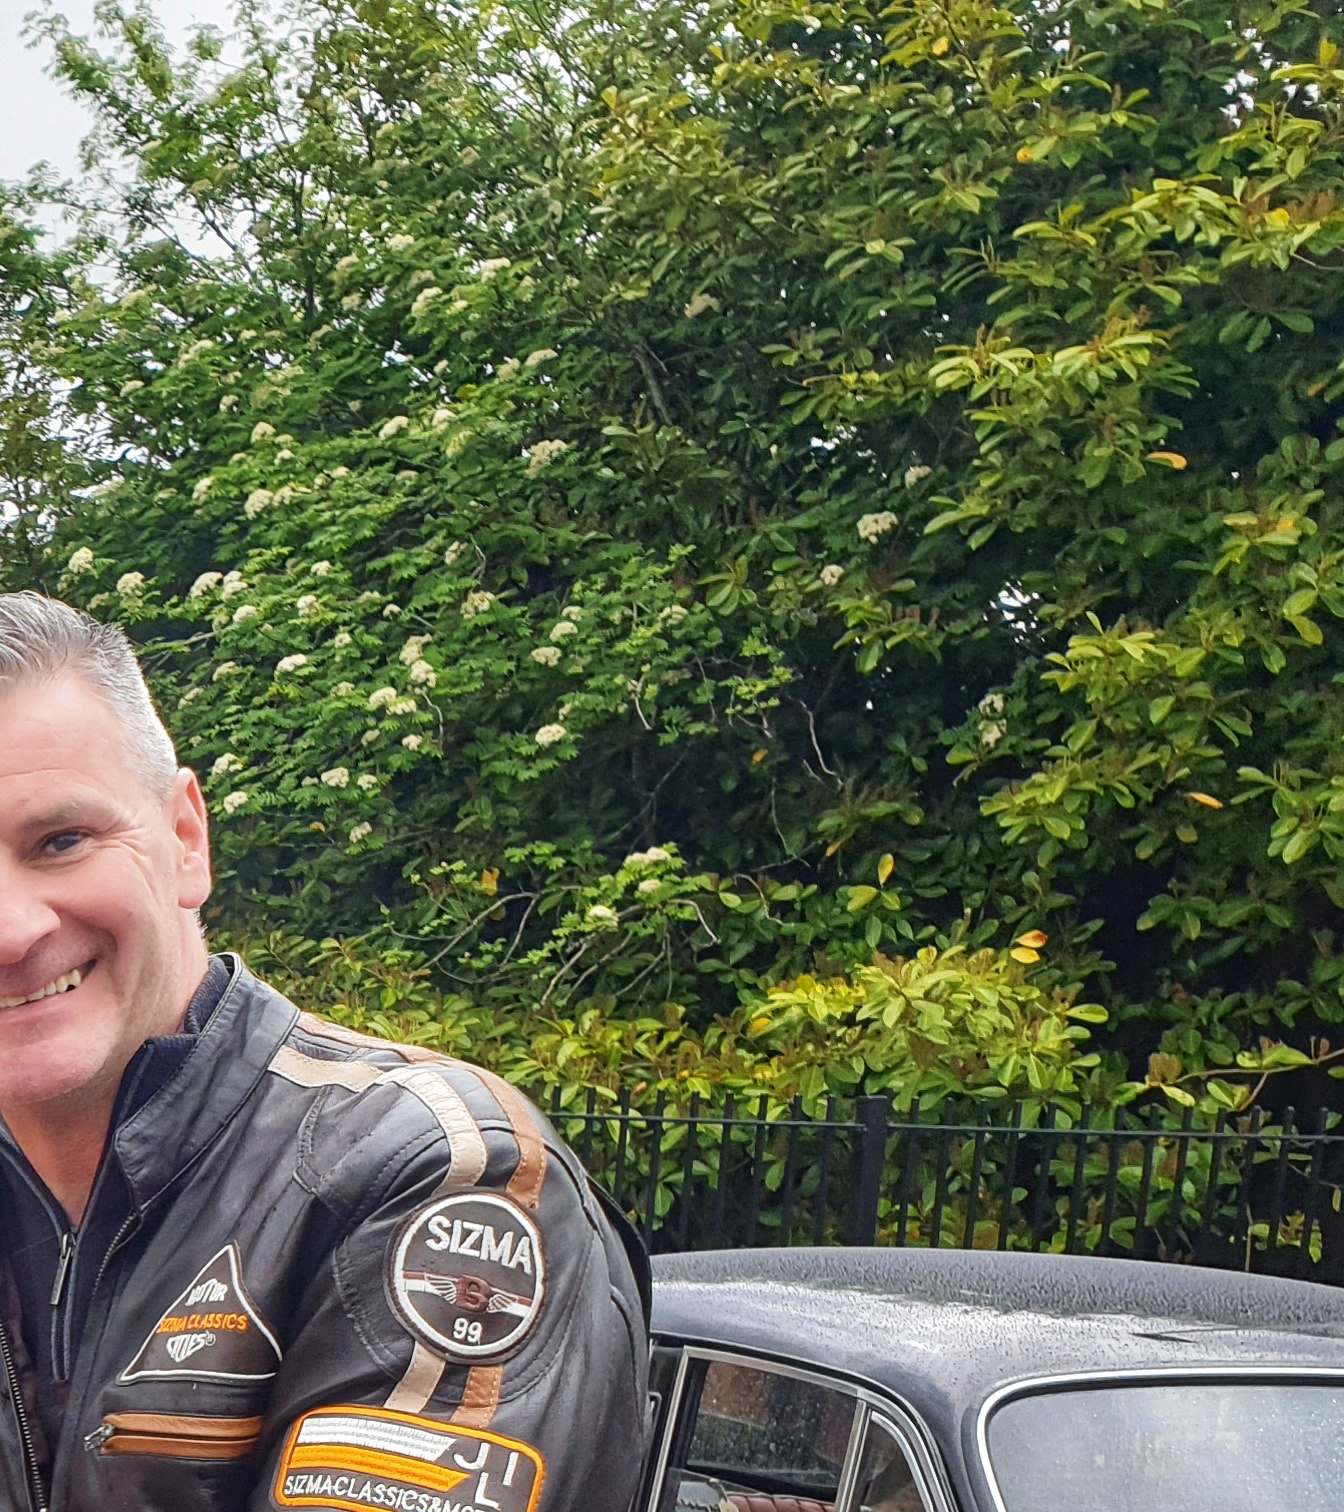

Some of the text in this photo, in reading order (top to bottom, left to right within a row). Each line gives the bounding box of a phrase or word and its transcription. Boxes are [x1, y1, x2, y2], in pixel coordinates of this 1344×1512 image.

[425, 1215, 532, 1275] SIZMA
[187, 1313, 249, 1333] CLASSICS
[453, 1318, 483, 1345] 99
